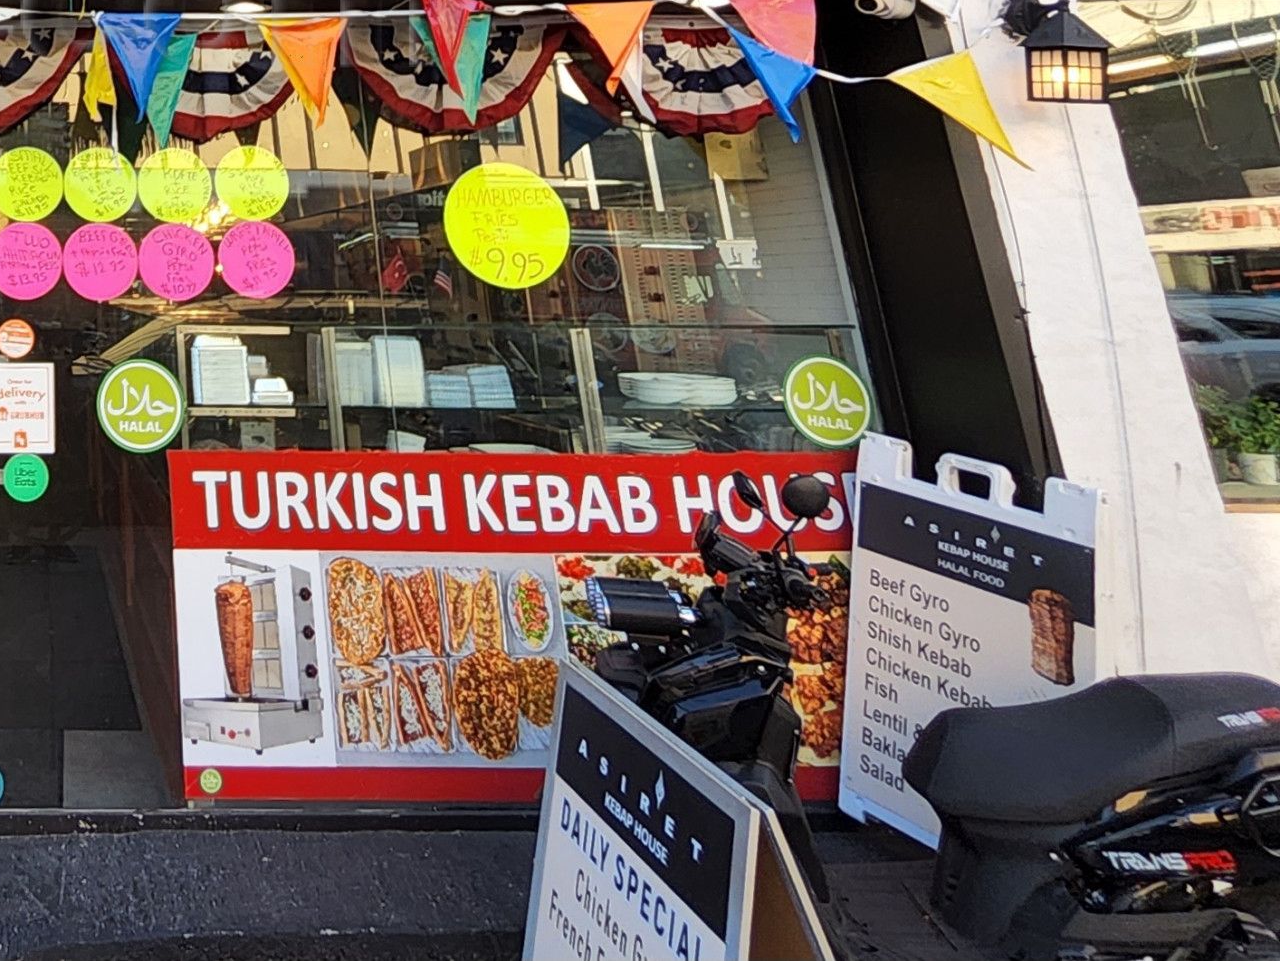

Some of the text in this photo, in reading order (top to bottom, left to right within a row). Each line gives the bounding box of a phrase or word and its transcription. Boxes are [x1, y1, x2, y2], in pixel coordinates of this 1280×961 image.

[456, 188, 558, 208] HAMBURGER
[470, 211, 519, 227] FRIES
[469, 246, 545, 284] $9.95
[107, 378, 175, 416] حلال
[792, 373, 864, 414] حلال
[119, 420, 163, 433] HALAL
[807, 414, 853, 432] HALAL
[14, 467, 38, 477] Uber
[14, 477, 38, 487] Eats
[192, 470, 447, 533] TURKISH
[462, 472, 657, 535] KEBAB
[903, 515, 1046, 568] ASIRET
[937, 540, 1010, 573] KEBAP HOUSE
[869, 568, 951, 617] Beef Gyro
[937, 558, 1005, 589] HALAL FOOD
[867, 594, 982, 654] Chicken Gyro
[866, 620, 972, 679] Shish Kebab
[864, 672, 900, 704] Fish
[865, 646, 994, 710] Chicken Kebab
[862, 699, 909, 737] Lentil
[858, 754, 905, 793] Salad
[577, 738, 703, 864] ASIRET
[603, 791, 670, 867] KEBAP HOUSE
[560, 796, 701, 961] DAILY SPECIAL
[548, 891, 592, 961] French
[575, 868, 628, 957] Chicken
